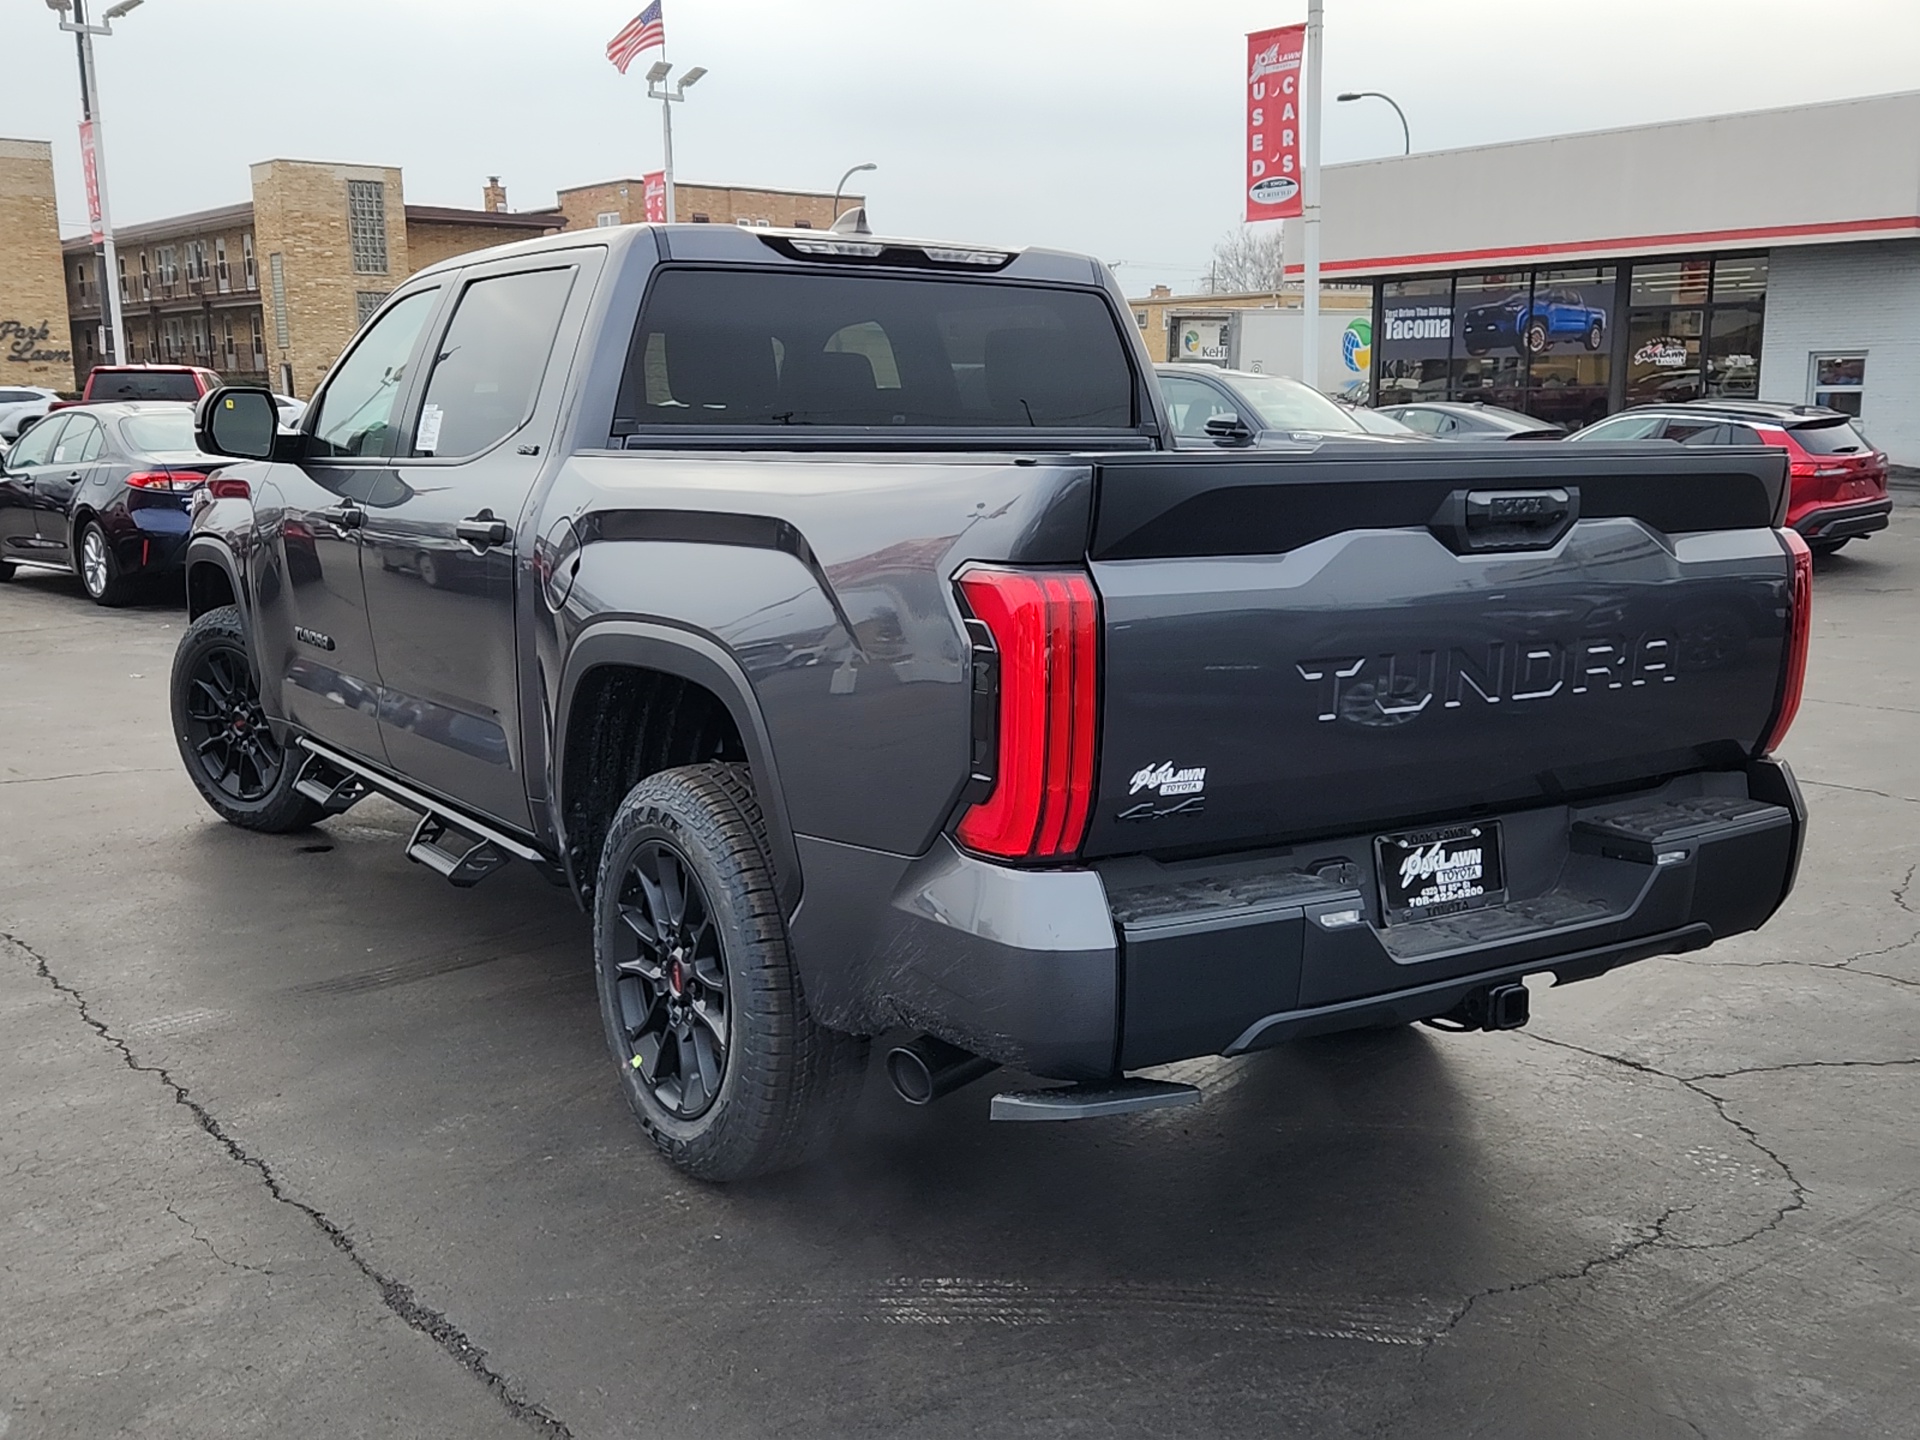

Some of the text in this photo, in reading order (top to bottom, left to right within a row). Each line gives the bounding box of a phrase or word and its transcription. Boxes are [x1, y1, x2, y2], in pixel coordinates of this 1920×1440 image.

[1253, 82, 1265, 177] USED
[1283, 76, 1295, 173] CARS
[0, 320, 49, 340] Park
[1385, 318, 1451, 340] Tacoma
[1296, 634, 1677, 721] TUNDRA
[1166, 783, 1197, 792] TOYOTA
[1411, 832, 1433, 844] OAK
[1442, 868, 1477, 882] TOYOTA
[1408, 886, 1484, 907] 708-422-5200
[1426, 901, 1469, 916] TOYOTA
